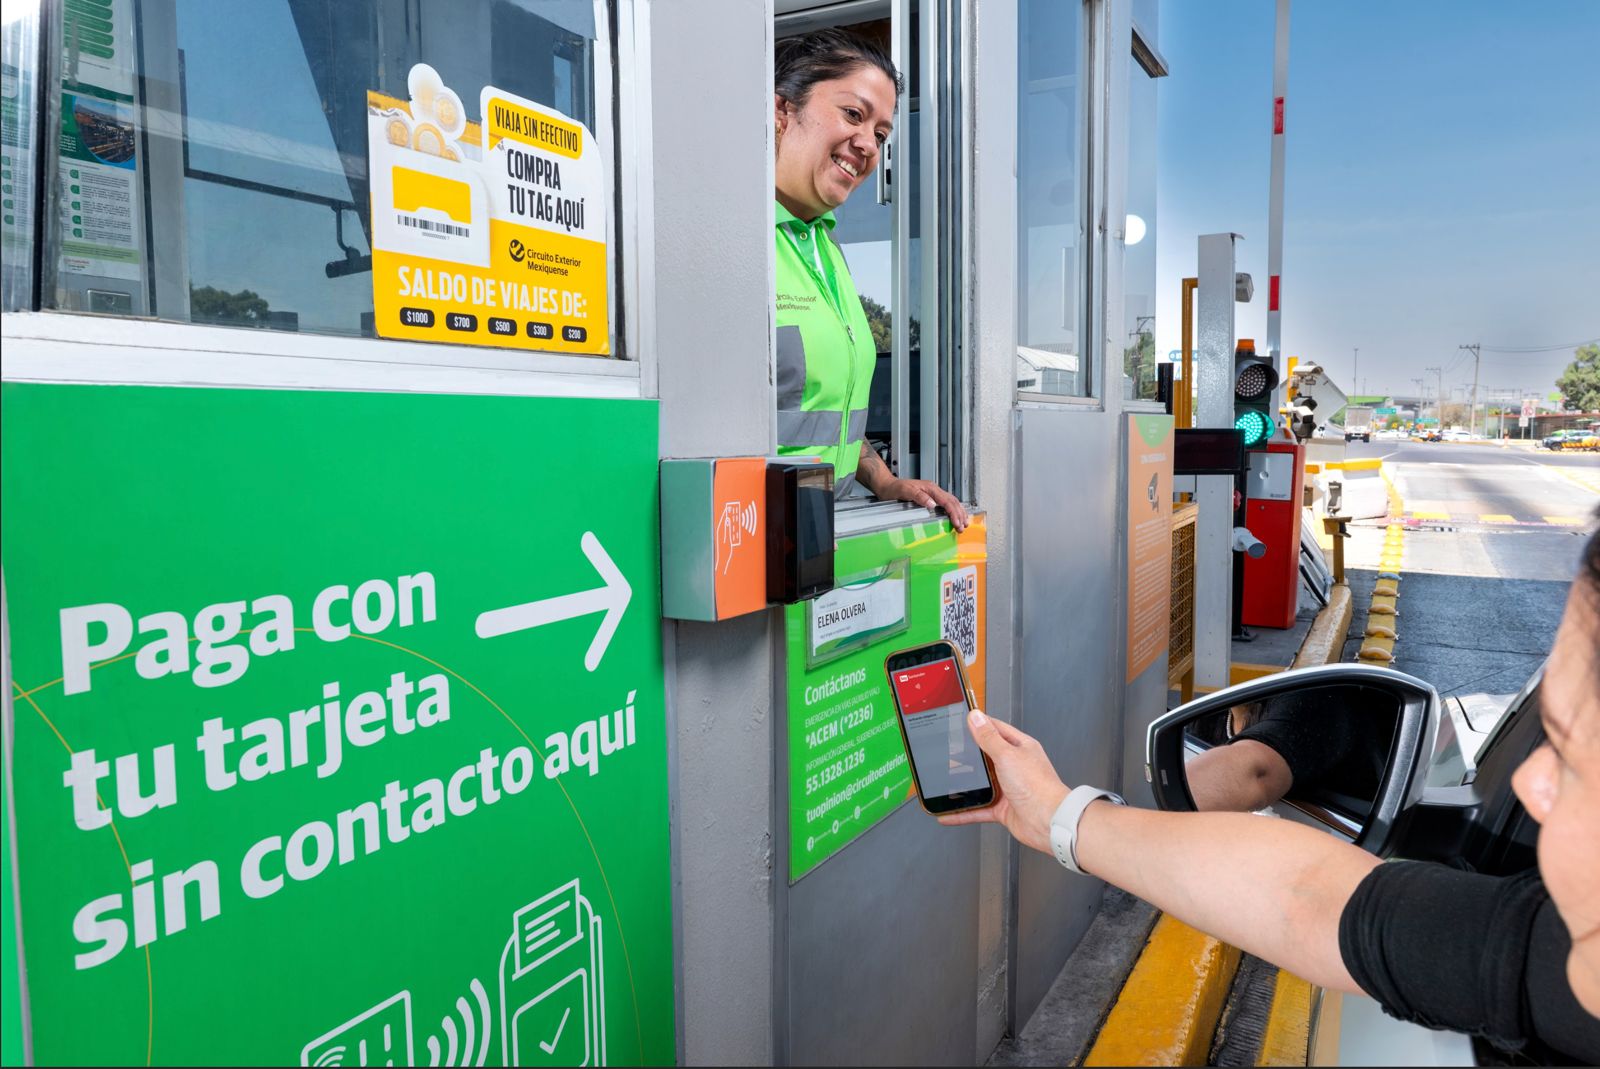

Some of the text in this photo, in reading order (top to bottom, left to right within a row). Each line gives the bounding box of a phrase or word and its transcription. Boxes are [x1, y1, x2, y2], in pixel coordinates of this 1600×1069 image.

[495, 105, 578, 152] VIAJA SIN EFECTIVO
[507, 148, 561, 190] COMPRA
[507, 184, 585, 232] TU TAG AQUÍ
[527, 249, 581, 267] Circuito Exterior
[527, 261, 569, 276] Mexiquense
[398, 266, 587, 319] SALDO DE VIAJES DE:
[406, 310, 429, 325] $1000
[454, 315, 471, 329] $700
[495, 320, 511, 333] $500
[533, 325, 547, 337] $300
[568, 329, 581, 340] $200
[59, 571, 437, 696] Paga con
[818, 610, 840, 628] ELENA
[841, 602, 867, 620] OLVERA
[804, 667, 867, 706] Contáctanos
[62, 671, 450, 831] tu tarjeta
[805, 747, 866, 796] 55.1328.1236
[73, 690, 637, 970] sin contacto aquí
